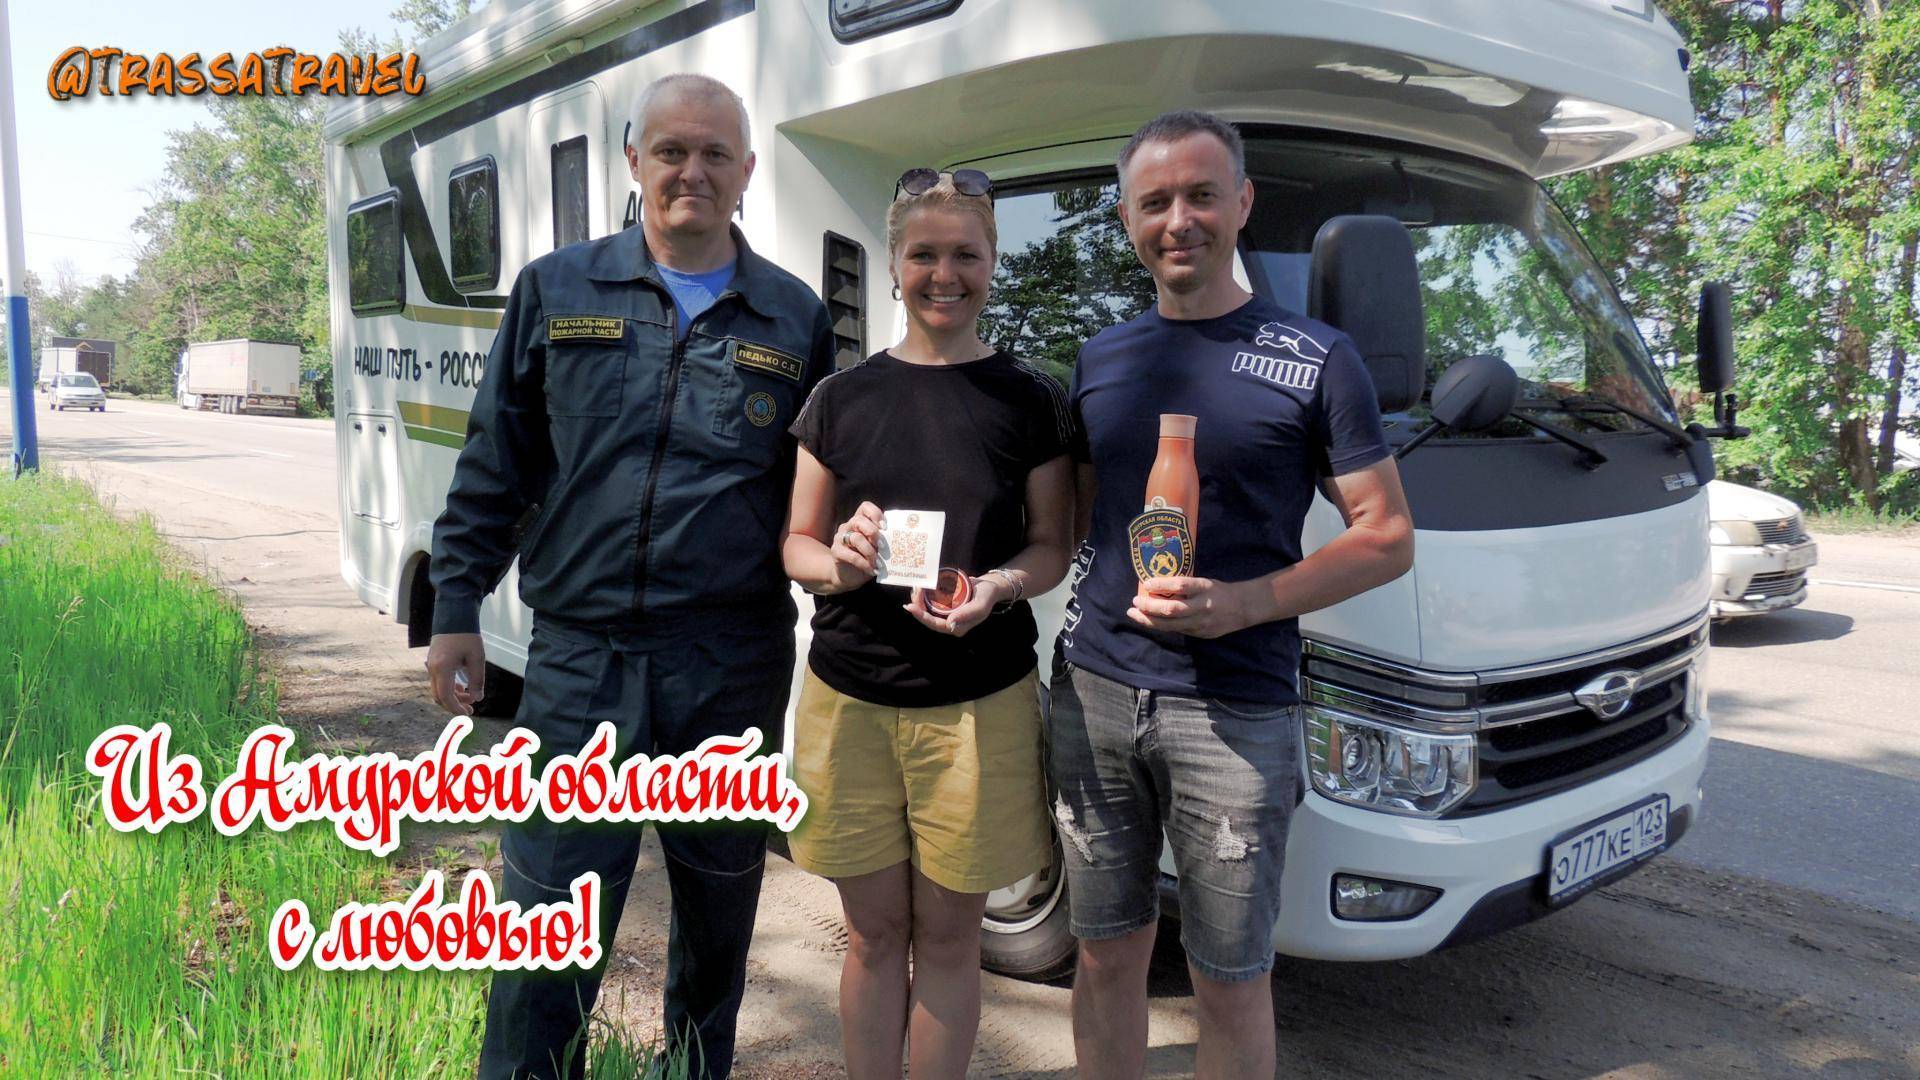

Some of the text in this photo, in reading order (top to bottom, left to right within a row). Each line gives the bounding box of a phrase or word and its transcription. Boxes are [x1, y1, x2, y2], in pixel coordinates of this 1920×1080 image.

[551, 327, 620, 336] ПОЖАРНОЙ ЧАСТИ
[556, 320, 616, 328] НАЧАЛЬНИК
[354, 346, 382, 376] НАШ
[386, 348, 422, 381] ПУТЬ
[738, 349, 779, 366] ПЕДЬКО
[1231, 351, 1319, 390] PUMA
[1635, 803, 1663, 838] 123
